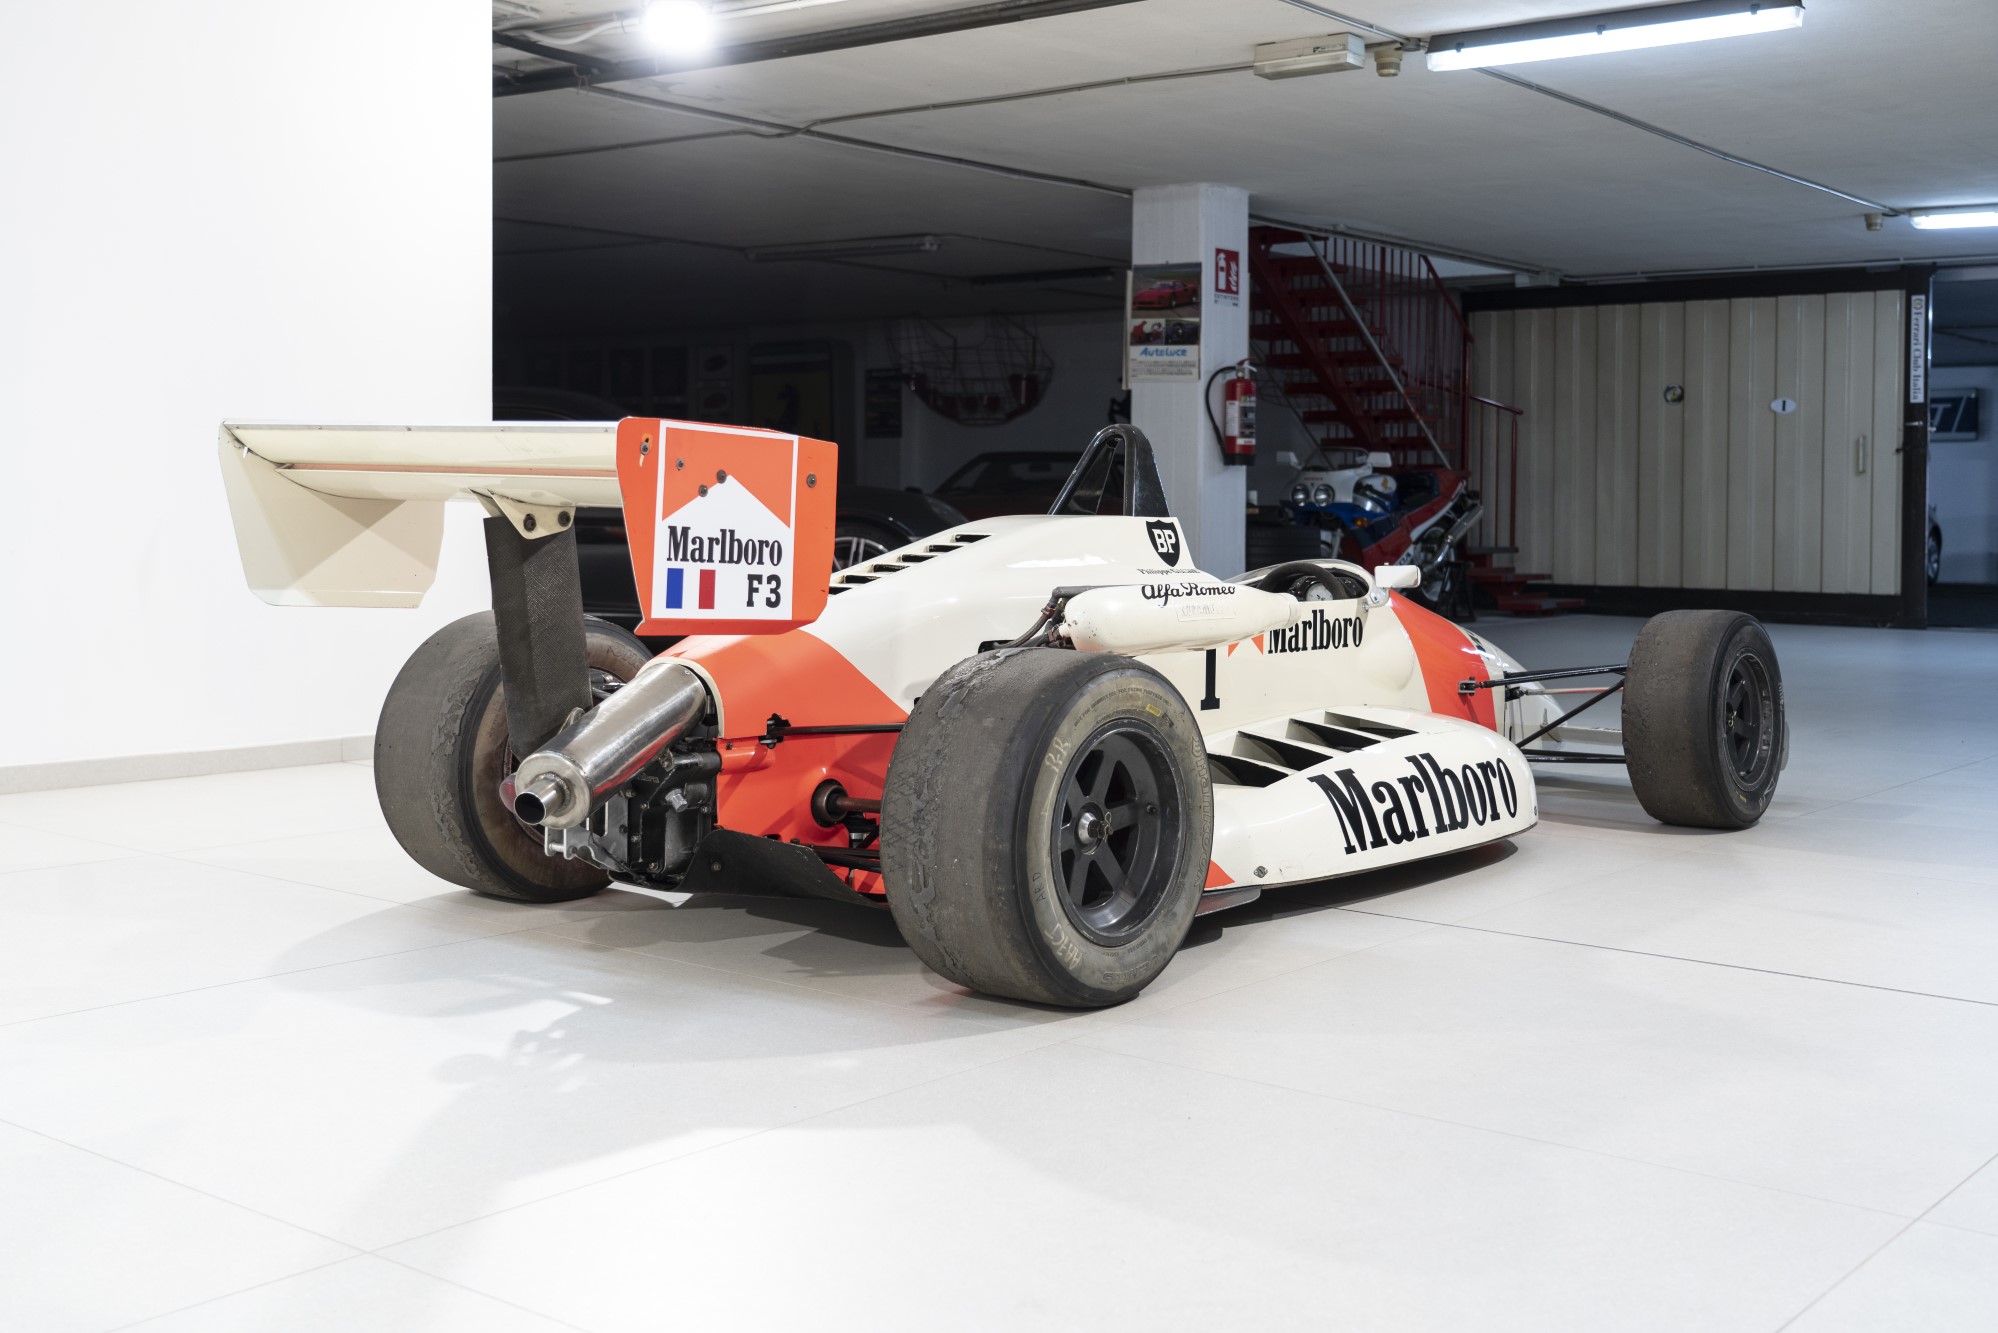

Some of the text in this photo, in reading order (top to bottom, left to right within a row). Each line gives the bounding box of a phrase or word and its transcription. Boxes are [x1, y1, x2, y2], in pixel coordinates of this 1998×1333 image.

[1912, 311, 1923, 400] Ferrari Club Italia
[667, 525, 782, 567] Marlboro
[1152, 529, 1176, 554] BP
[746, 573, 782, 608] F3
[1141, 582, 1236, 608] Alfa Romeo
[1267, 609, 1363, 654] Marlboro
[1307, 752, 1518, 855] Marlboro
